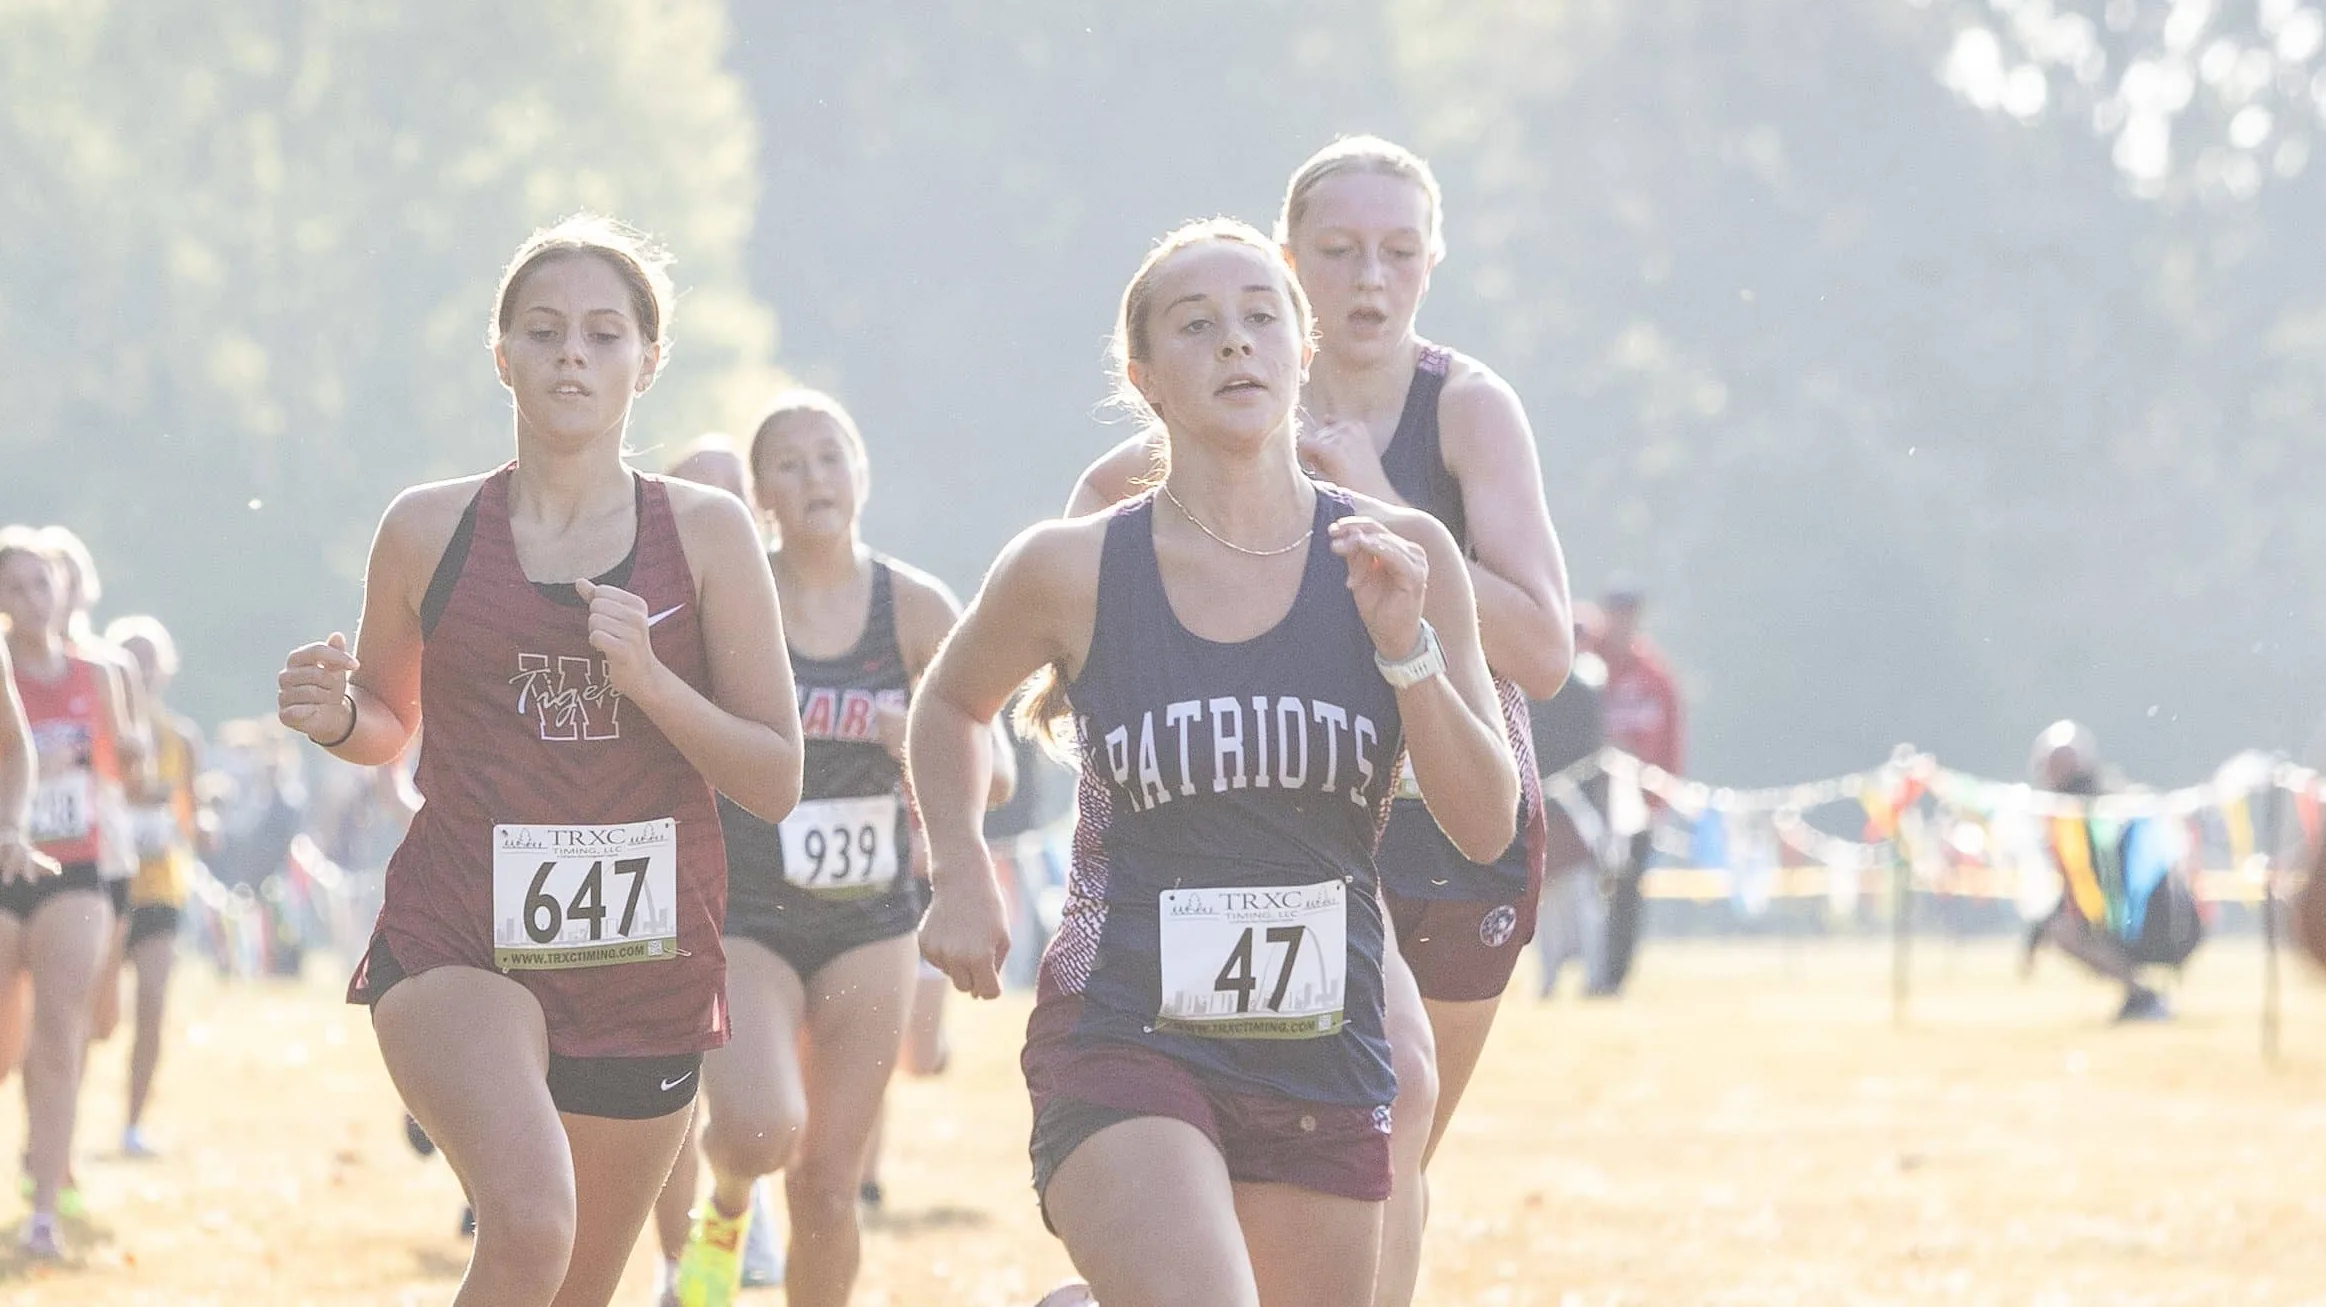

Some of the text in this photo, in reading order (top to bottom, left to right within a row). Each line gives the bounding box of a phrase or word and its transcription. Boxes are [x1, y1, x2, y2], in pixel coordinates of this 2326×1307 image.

[1105, 696, 1378, 813] PATRIOTS
[547, 828, 626, 846] TRXC
[604, 845, 622, 854] LLC
[805, 825, 877, 883] 939
[523, 856, 651, 944] 647
[1219, 891, 1302, 910] TRXC
[511, 945, 645, 965] WWW.TRXCTIMING.COM
[1214, 925, 1306, 1012] 47
[1172, 1019, 1316, 1035] WW.TRXCTIMING.COM
